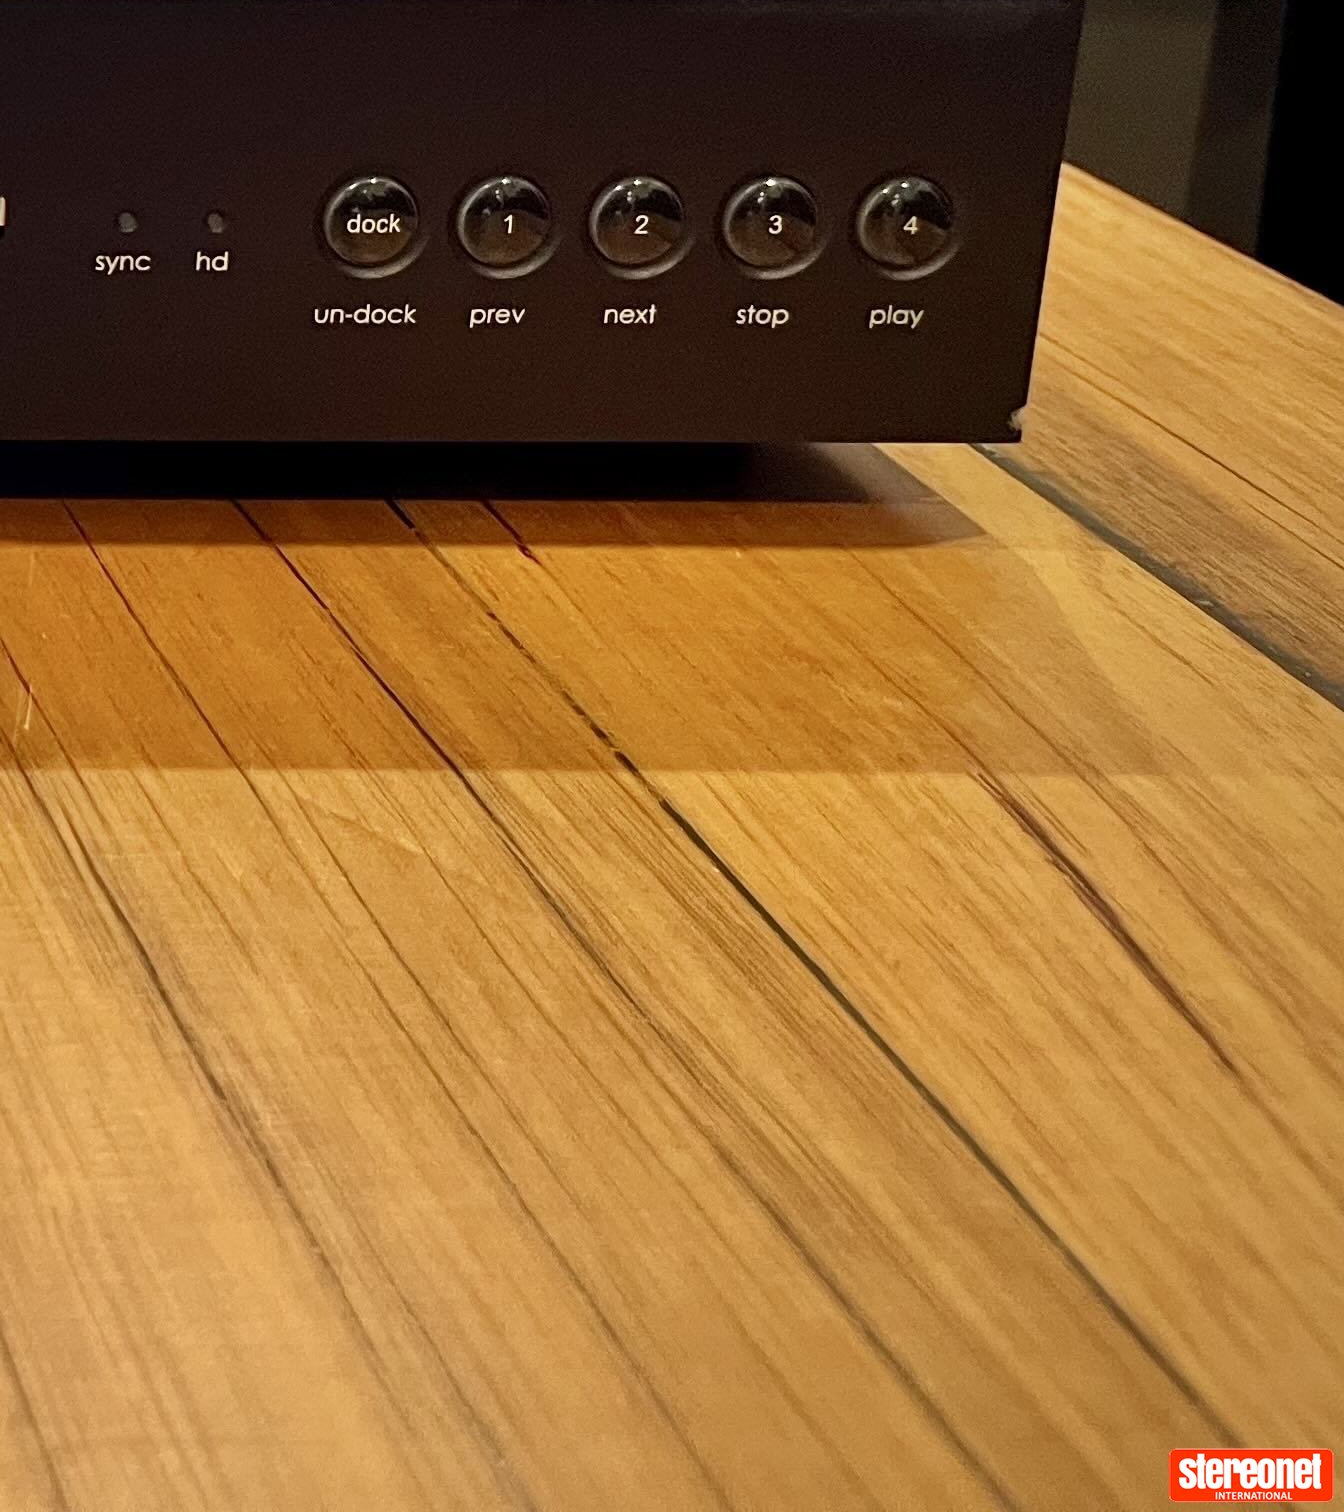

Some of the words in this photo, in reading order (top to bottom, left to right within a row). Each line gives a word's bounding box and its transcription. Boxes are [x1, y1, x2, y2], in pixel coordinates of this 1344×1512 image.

[346, 213, 401, 234] dock
[503, 214, 513, 234] 1
[634, 214, 649, 235] 2
[768, 214, 783, 235] 3
[903, 215, 919, 235] 4
[95, 255, 151, 276] sync
[195, 251, 229, 272] hd
[314, 303, 417, 325] un-dock
[469, 308, 526, 329] prev
[603, 303, 657, 325] next
[735, 304, 790, 329] stop
[868, 304, 924, 329] play
